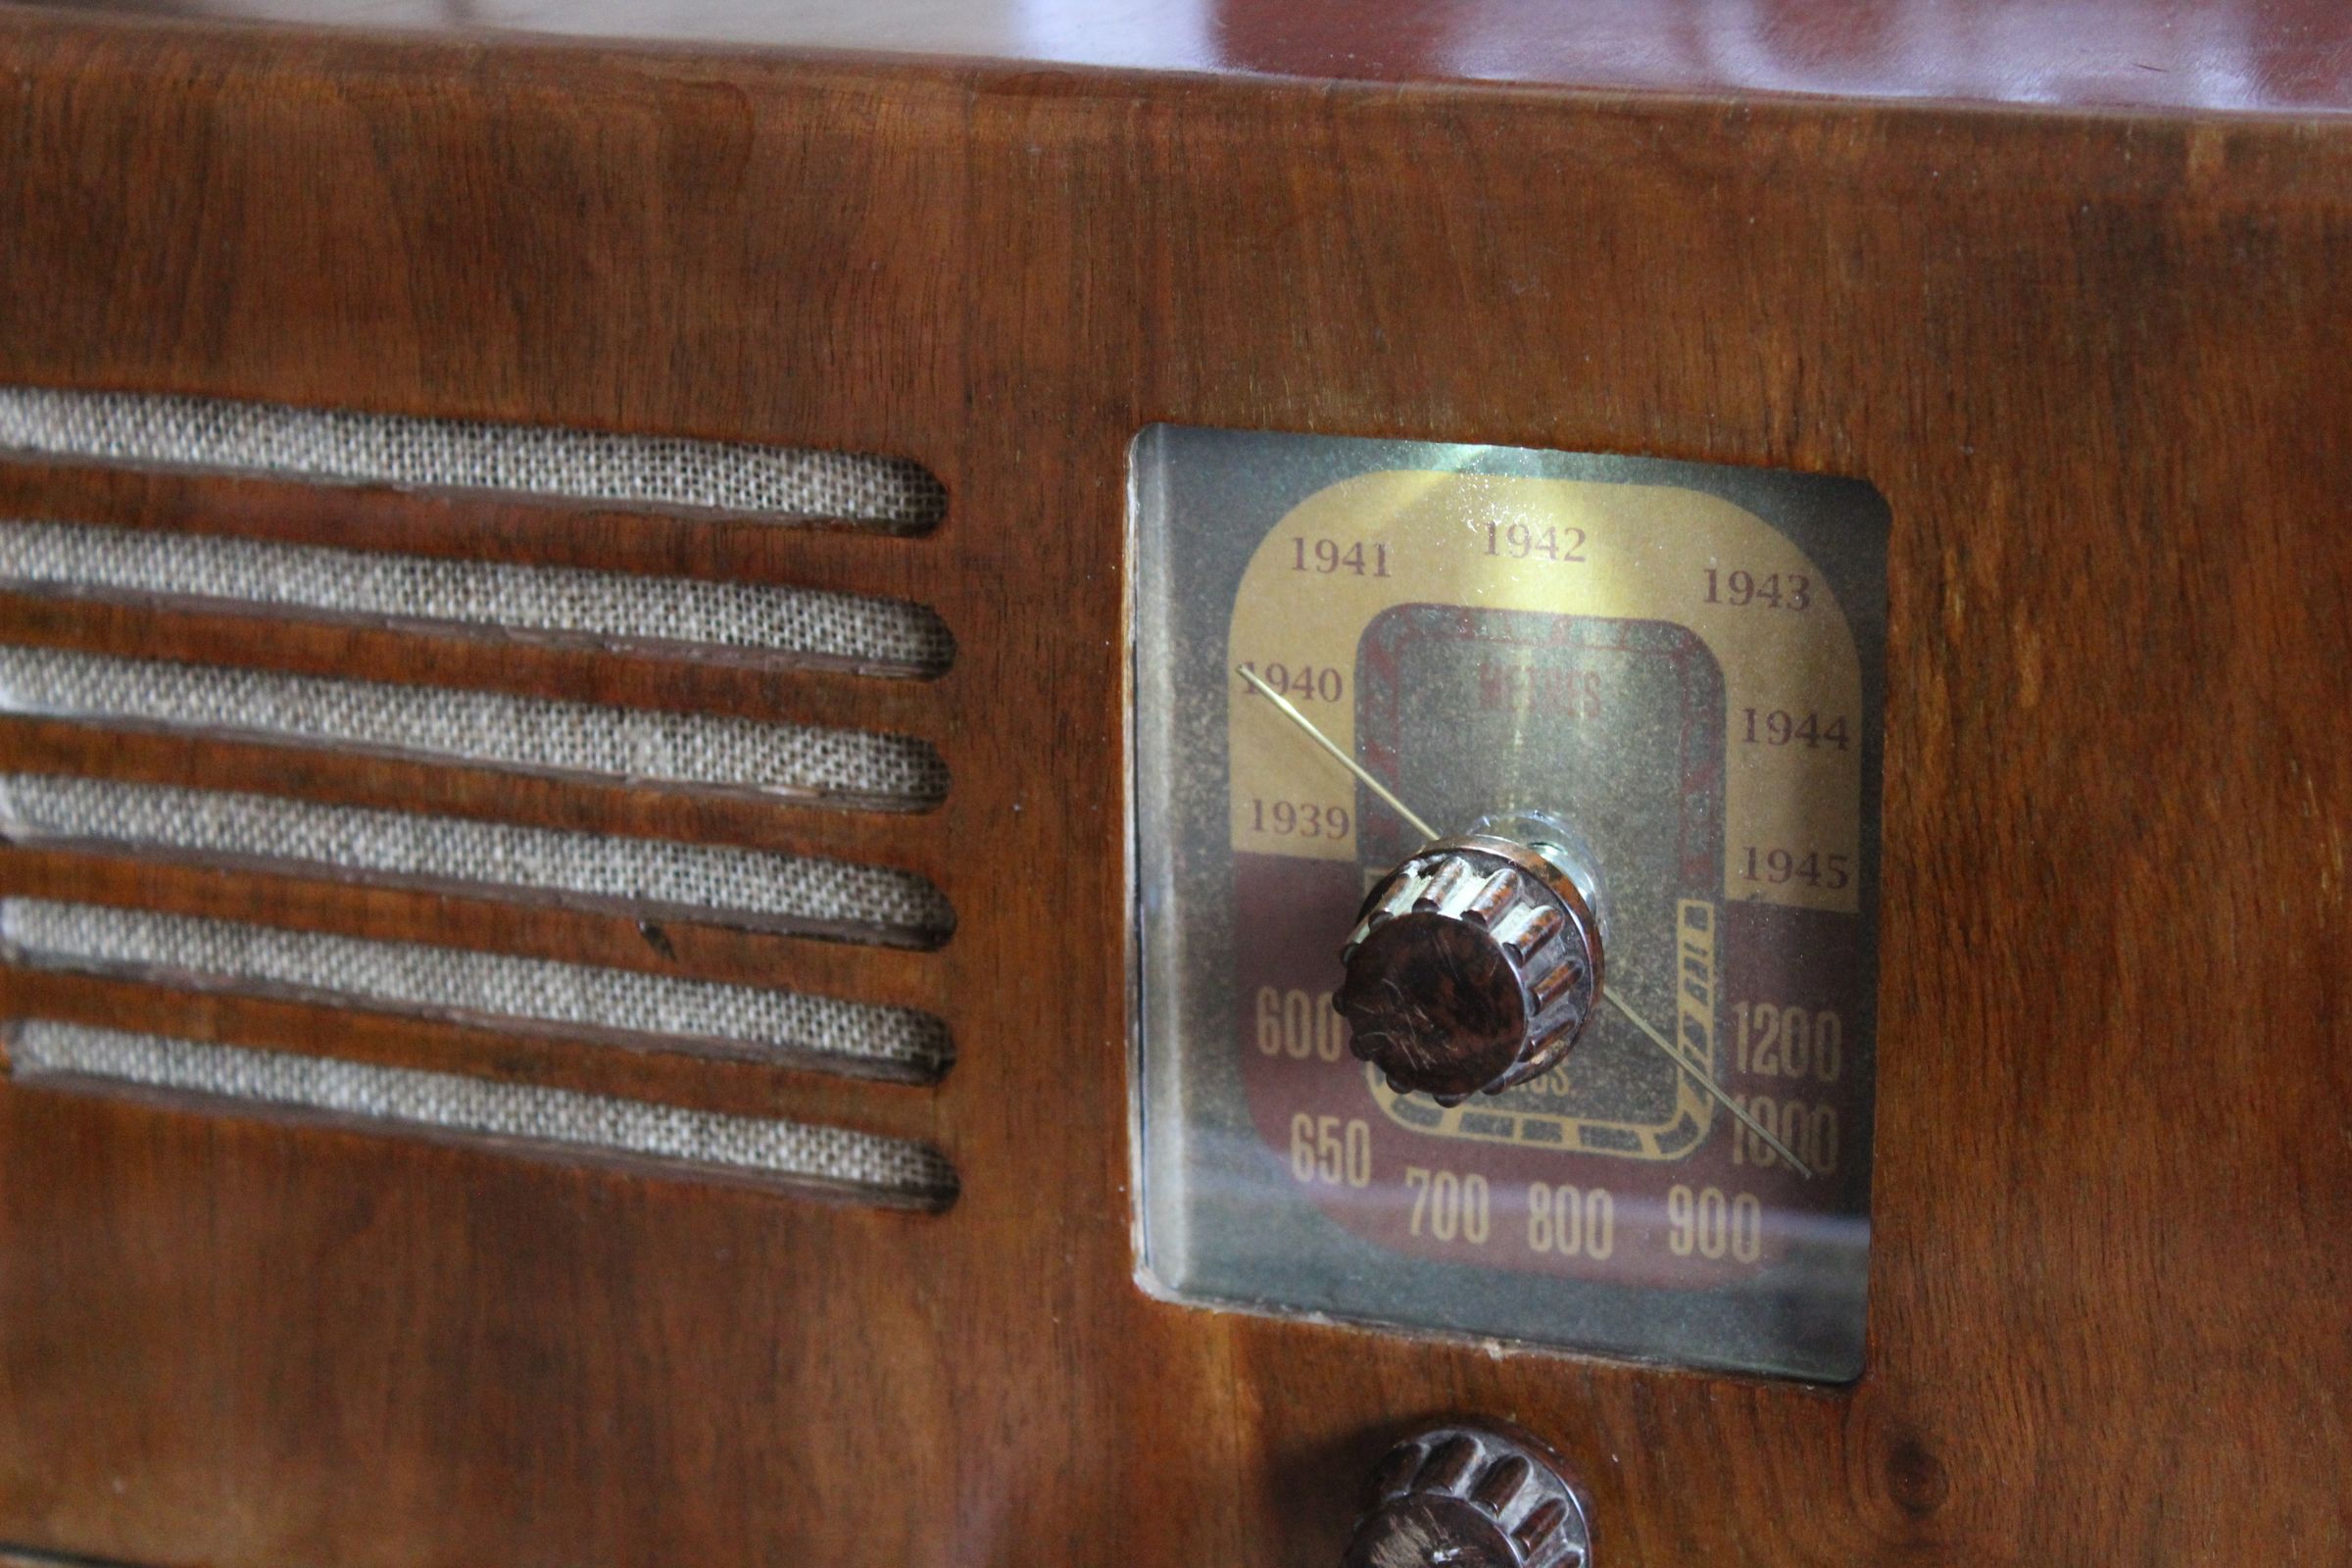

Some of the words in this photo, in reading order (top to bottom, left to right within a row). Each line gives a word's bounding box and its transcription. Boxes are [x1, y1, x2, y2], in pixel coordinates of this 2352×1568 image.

[1291, 536, 1391, 578] 1941
[1481, 520, 1587, 564] 1942
[1703, 568, 1811, 612] 1943
[1241, 661, 1344, 703] 1940
[1741, 708, 1850, 752] 1944
[1250, 798, 1350, 841] 1939
[1743, 847, 1849, 889] 1945
[1256, 986, 1344, 1062] 600
[1732, 1001, 1842, 1082] 1200
[1290, 1114, 1371, 1188] 650
[1732, 1093, 1839, 1174] 1000
[1404, 1166, 1490, 1244] 700
[1528, 1183, 1613, 1260] 800
[1670, 1185, 1762, 1264] 900
